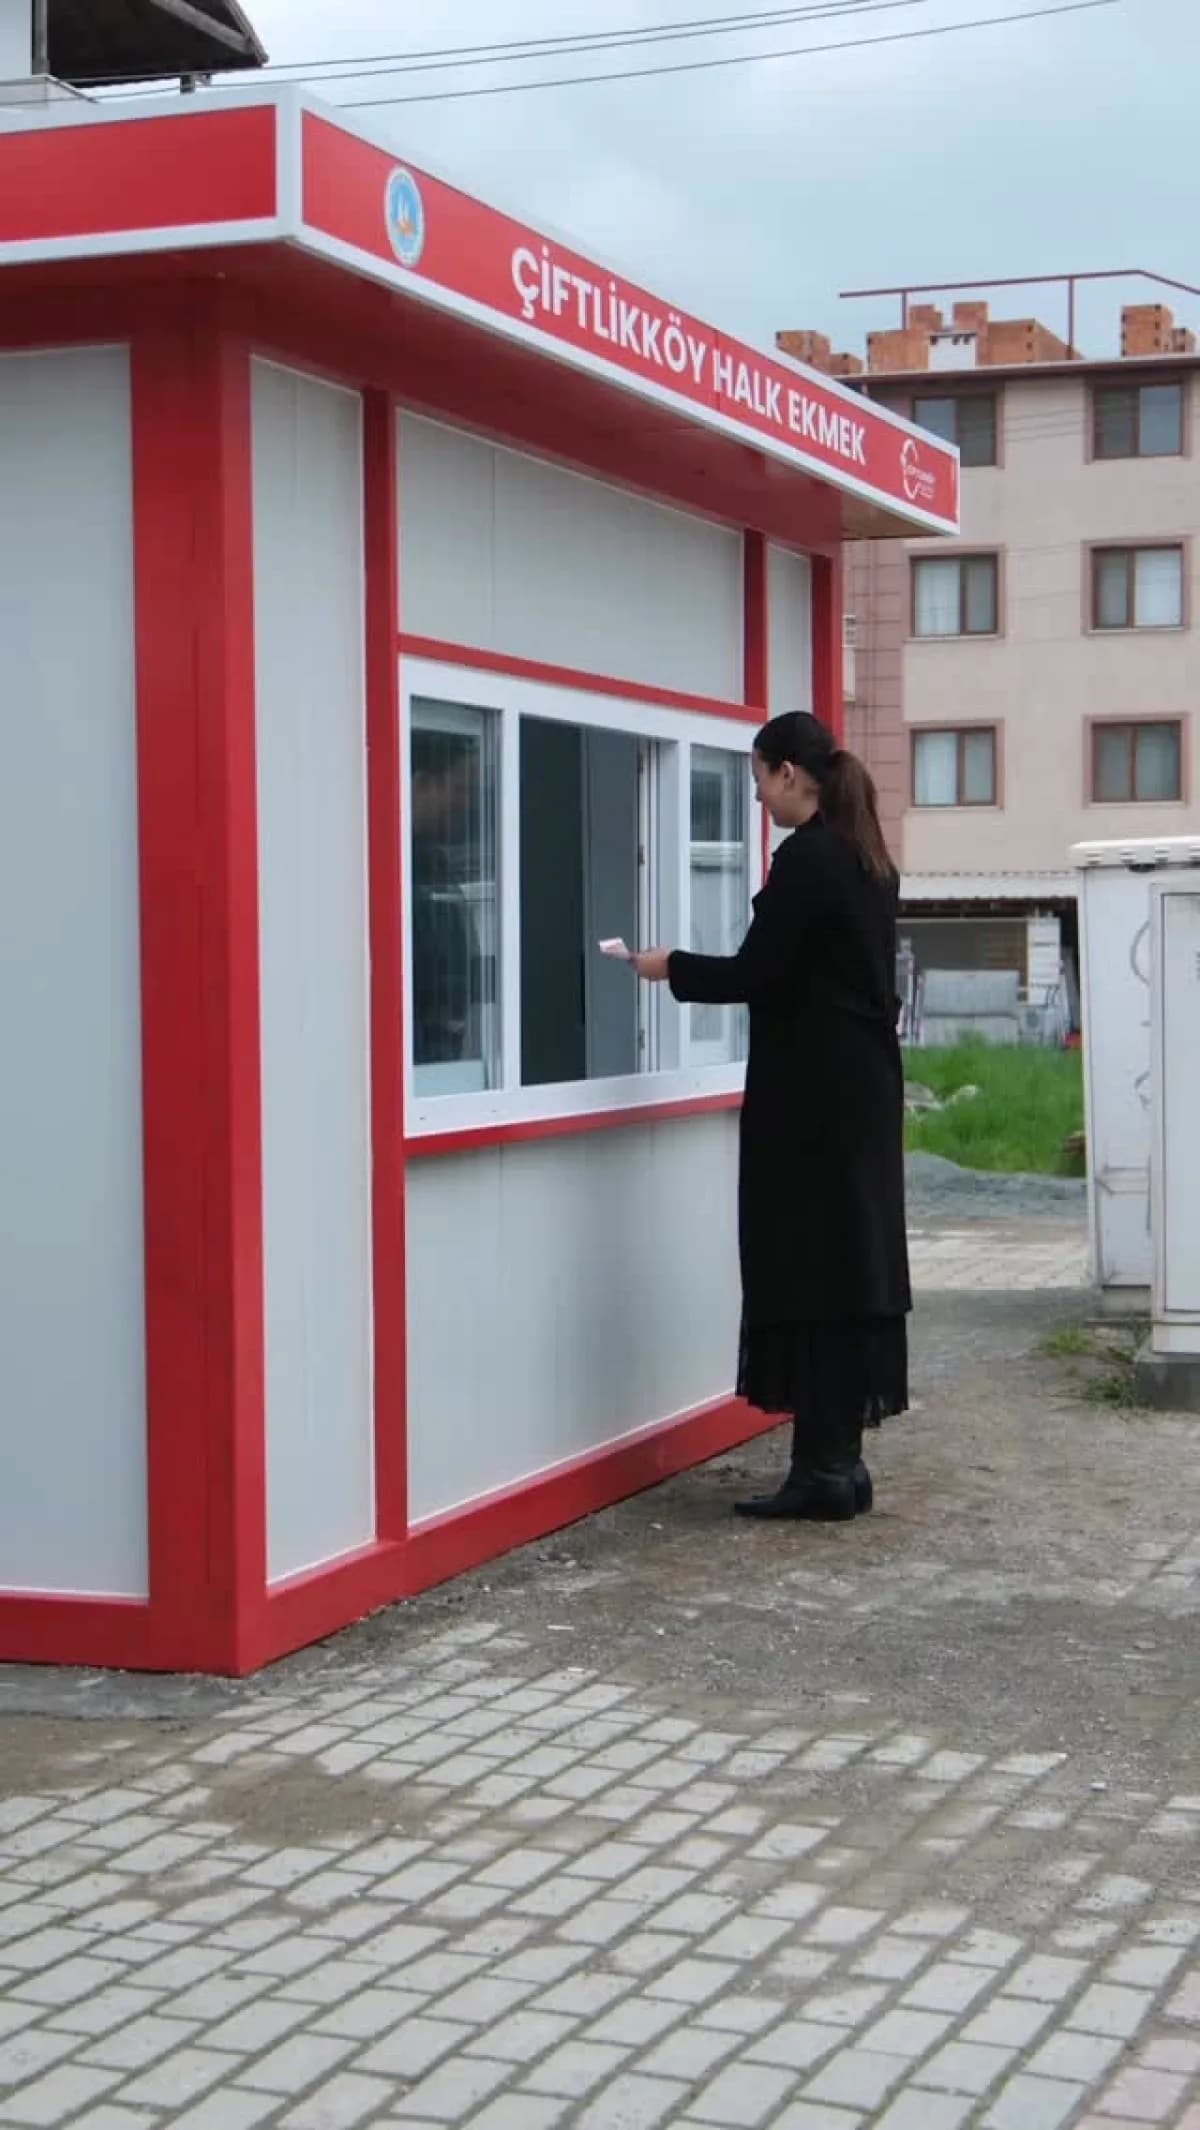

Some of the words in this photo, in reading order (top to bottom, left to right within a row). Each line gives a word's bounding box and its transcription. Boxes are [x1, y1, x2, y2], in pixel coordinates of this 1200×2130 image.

[511, 245, 706, 384] ÇİFTLİKKÖY
[712, 349, 783, 425] HALK
[788, 390, 866, 464] EKMEK
